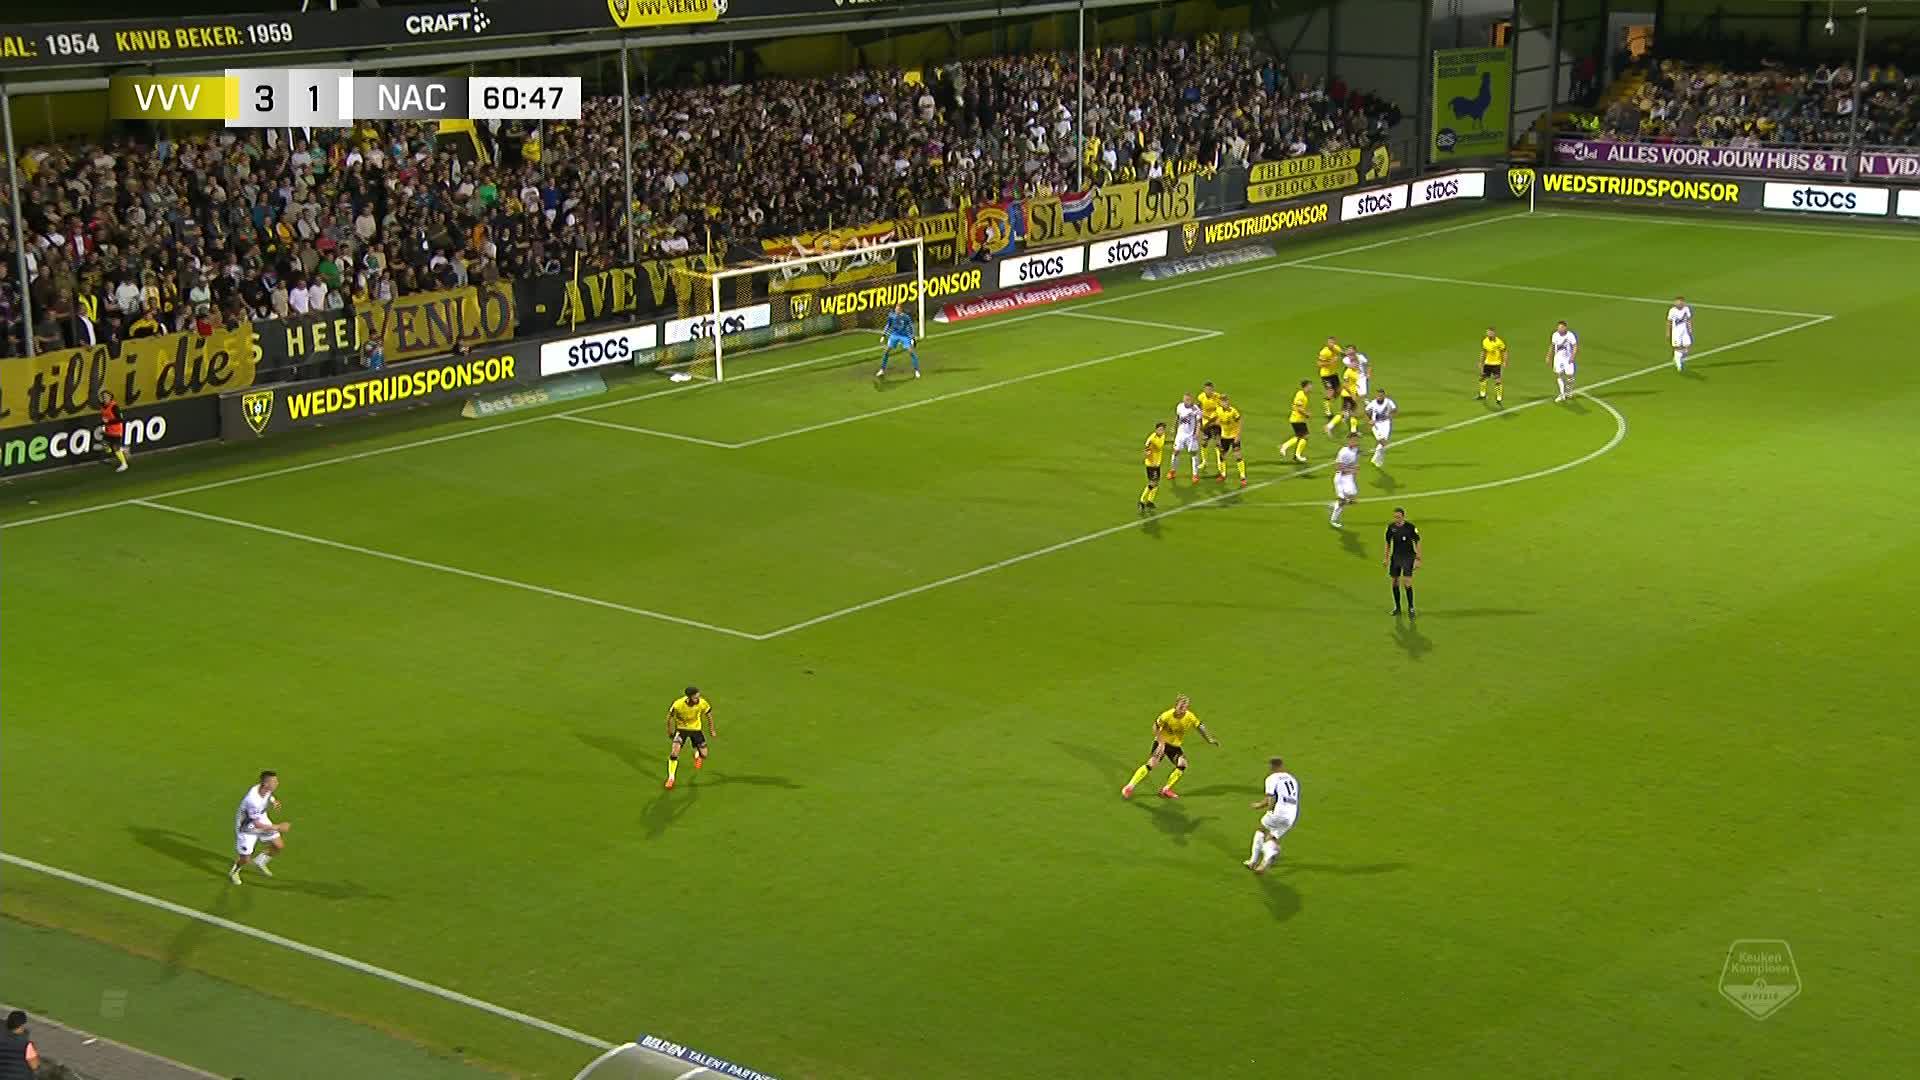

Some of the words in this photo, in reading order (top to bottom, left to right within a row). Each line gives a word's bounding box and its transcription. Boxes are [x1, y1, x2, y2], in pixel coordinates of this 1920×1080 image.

[115, 30, 171, 51] KNVB
[175, 26, 244, 49] BEKER:
[247, 22, 293, 44] 1959
[406, 13, 472, 34] CRAFT
[0, 34, 37, 57] AL:
[46, 32, 100, 55] 1954
[1257, 162, 1283, 180] THE
[1287, 157, 1316, 174] OLD
[1607, 145, 1658, 163] ALLES
[1663, 149, 1709, 166] VOOR
[1712, 149, 1764, 168] JOUW
[1766, 152, 1810, 171] HUIS
[1812, 154, 1825, 172] &
[1829, 154, 1874, 174] TUN
[1426, 179, 1459, 201] stocs
[1543, 174, 1739, 203] WEDSTRIJDSPONSOR
[1792, 187, 1857, 210] stocs
[1358, 194, 1393, 215] stocs
[1204, 203, 1329, 245] WEDSTRIJDSPONSOR
[1107, 239, 1150, 264] stocs
[1018, 255, 1065, 282] stocs
[556, 266, 638, 326] AVE
[361, 288, 513, 353] VENLO
[567, 335, 630, 368] stocs
[28, 346, 110, 422] till
[125, 353, 142, 406] i
[155, 335, 236, 400] die
[287, 355, 516, 420] WEDSTRIJDSPONSOR
[687, 1050, 729, 1071] TALENT
